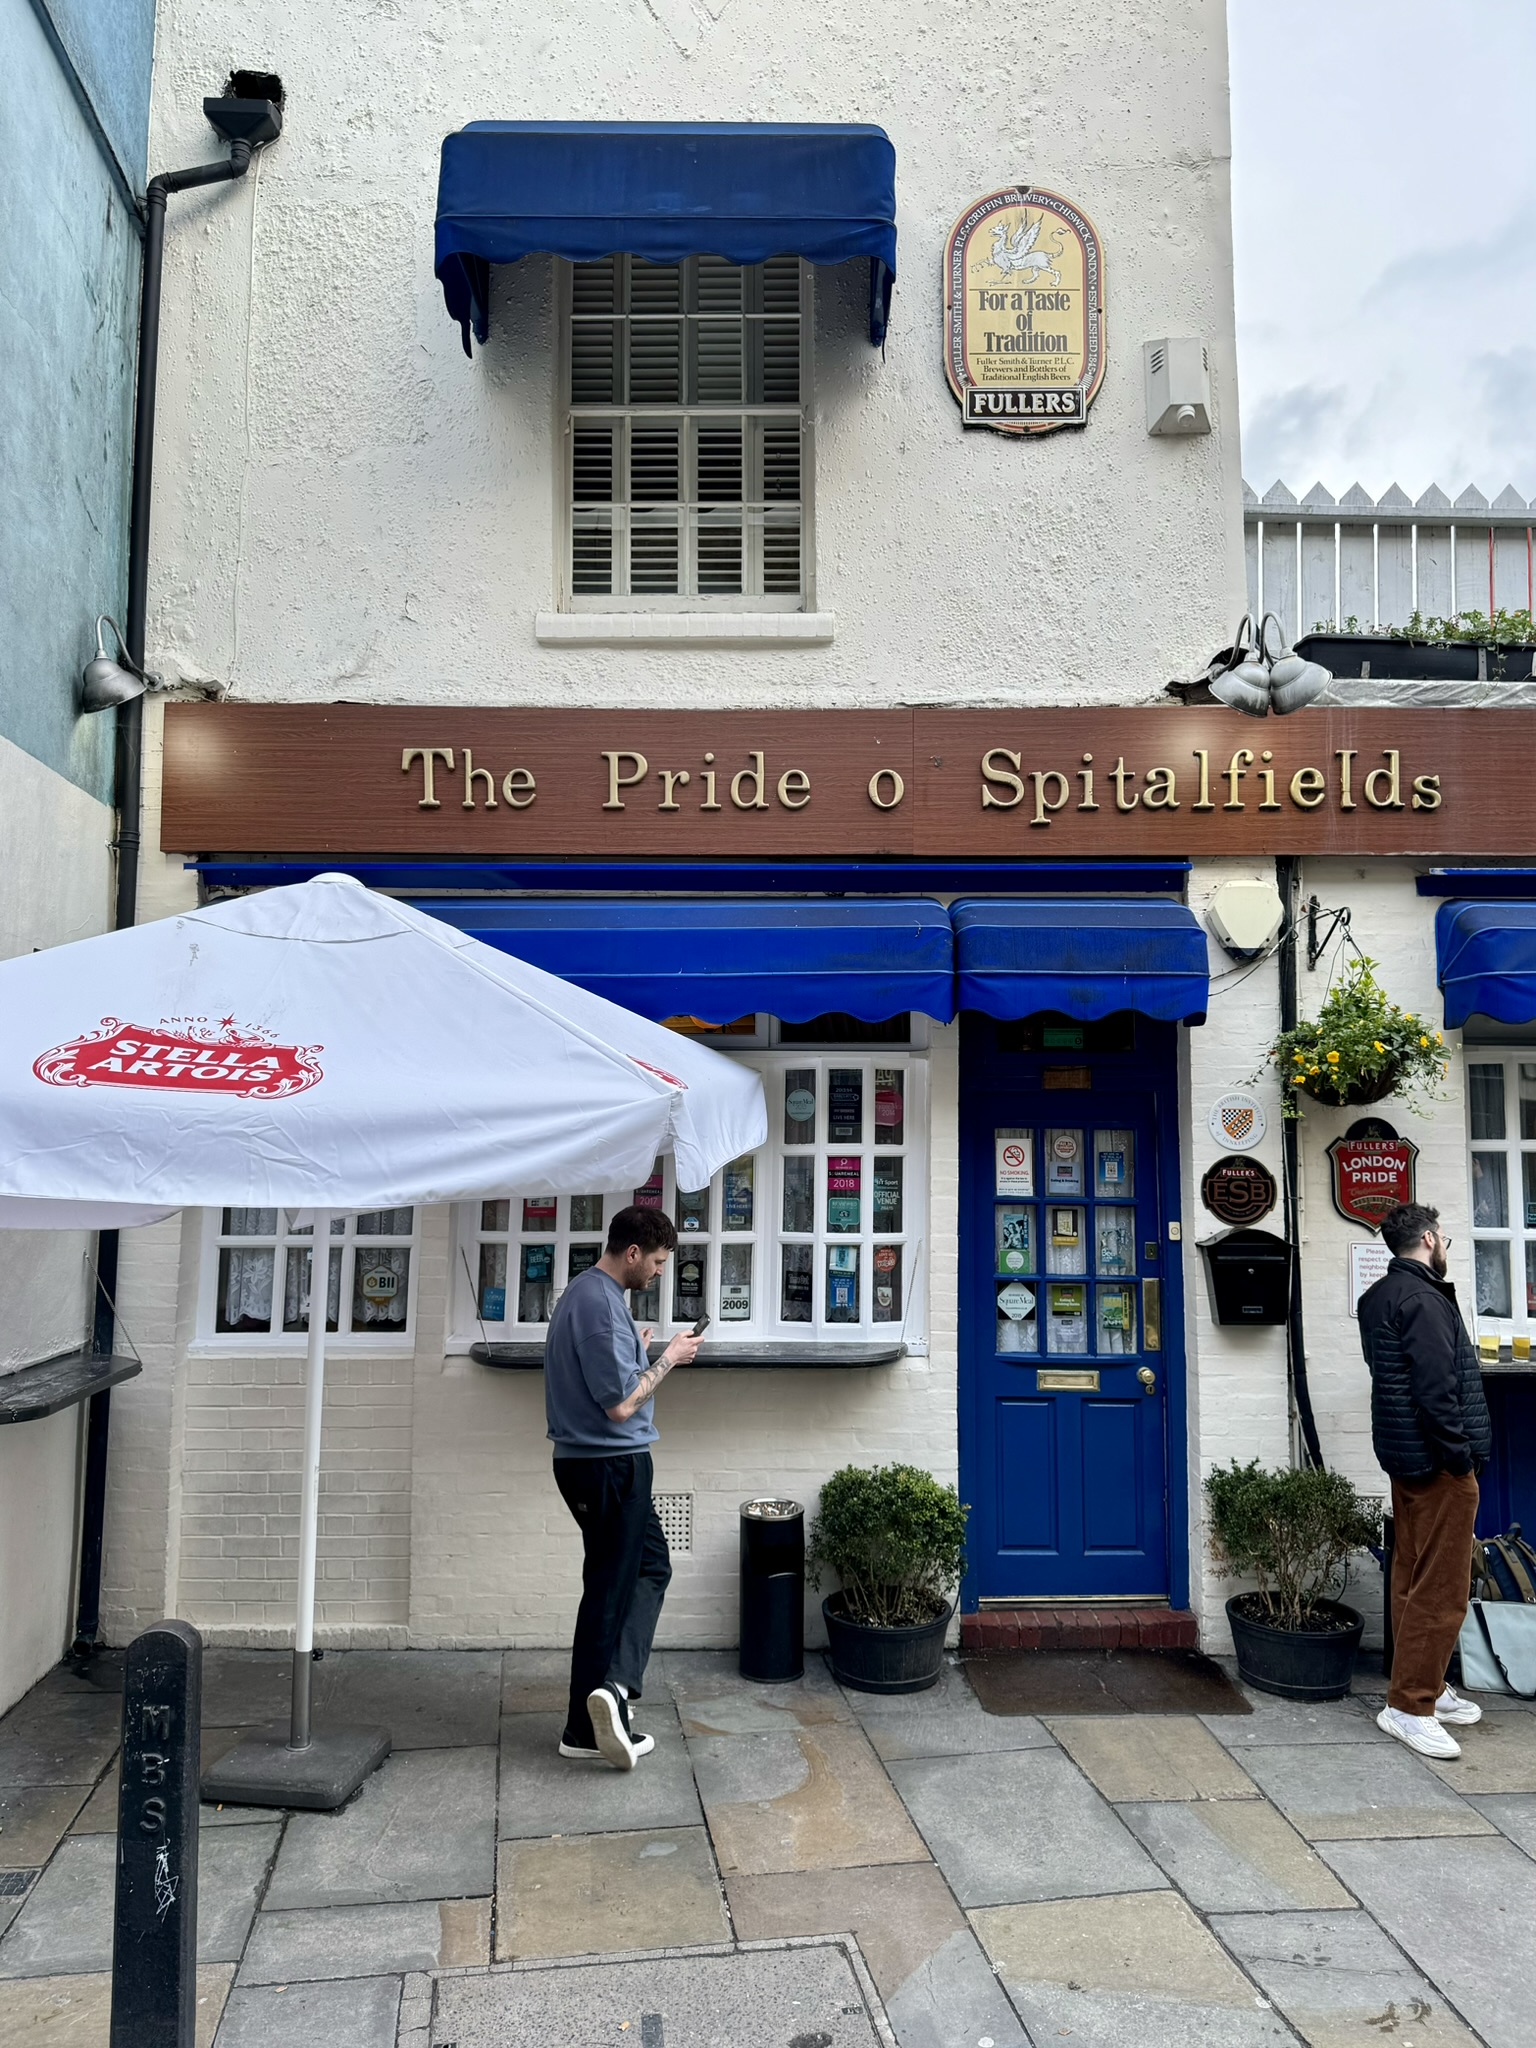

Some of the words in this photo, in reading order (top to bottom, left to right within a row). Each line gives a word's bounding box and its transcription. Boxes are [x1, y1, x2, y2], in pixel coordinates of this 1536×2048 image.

[1004, 194, 1051, 206] BREWERY
[966, 197, 1003, 226] GRIFFIN
[1052, 202, 1092, 241] CHISWICK
[953, 250, 962, 290] TURNER
[1086, 242, 1098, 285] LONDON
[979, 290, 1008, 311] For
[1011, 293, 1023, 311] a
[1024, 290, 1070, 311] Taste
[953, 300, 962, 334] SMITH
[1016, 311, 1033, 332] of
[1088, 290, 1098, 352] ESTABLISHED
[984, 332, 1068, 352] Tradition
[953, 336, 964, 374] FULLER
[976, 358, 997, 366] Fuller
[998, 358, 1021, 366] Smith
[1021, 358, 1026, 366] &
[1028, 358, 1053, 366] Turner
[1024, 373, 1050, 382] English
[974, 393, 1076, 414] FULLERS
[400, 747, 538, 809] The
[600, 750, 812, 812] Pride
[868, 768, 905, 809] o
[980, 748, 1443, 826] Spitalfields
[160, 1016, 209, 1026] ANNO
[244, 1022, 282, 1039] 1366
[110, 1040, 281, 1070] STELLA
[87, 1056, 274, 1082] ARTOIS
[1218, 1096, 1240, 1109] BRITISH
[1350, 1142, 1395, 1150] FULLER'S
[1342, 1156, 1406, 1172] LONDON
[833, 1179, 855, 1188] 2018
[1352, 1172, 1398, 1183] PRIDE
[640, 1197, 658, 1206] 2017
[1213, 1180, 1266, 1204] ESB
[379, 1277, 394, 1288] BII
[722, 1300, 748, 1310] 2009
